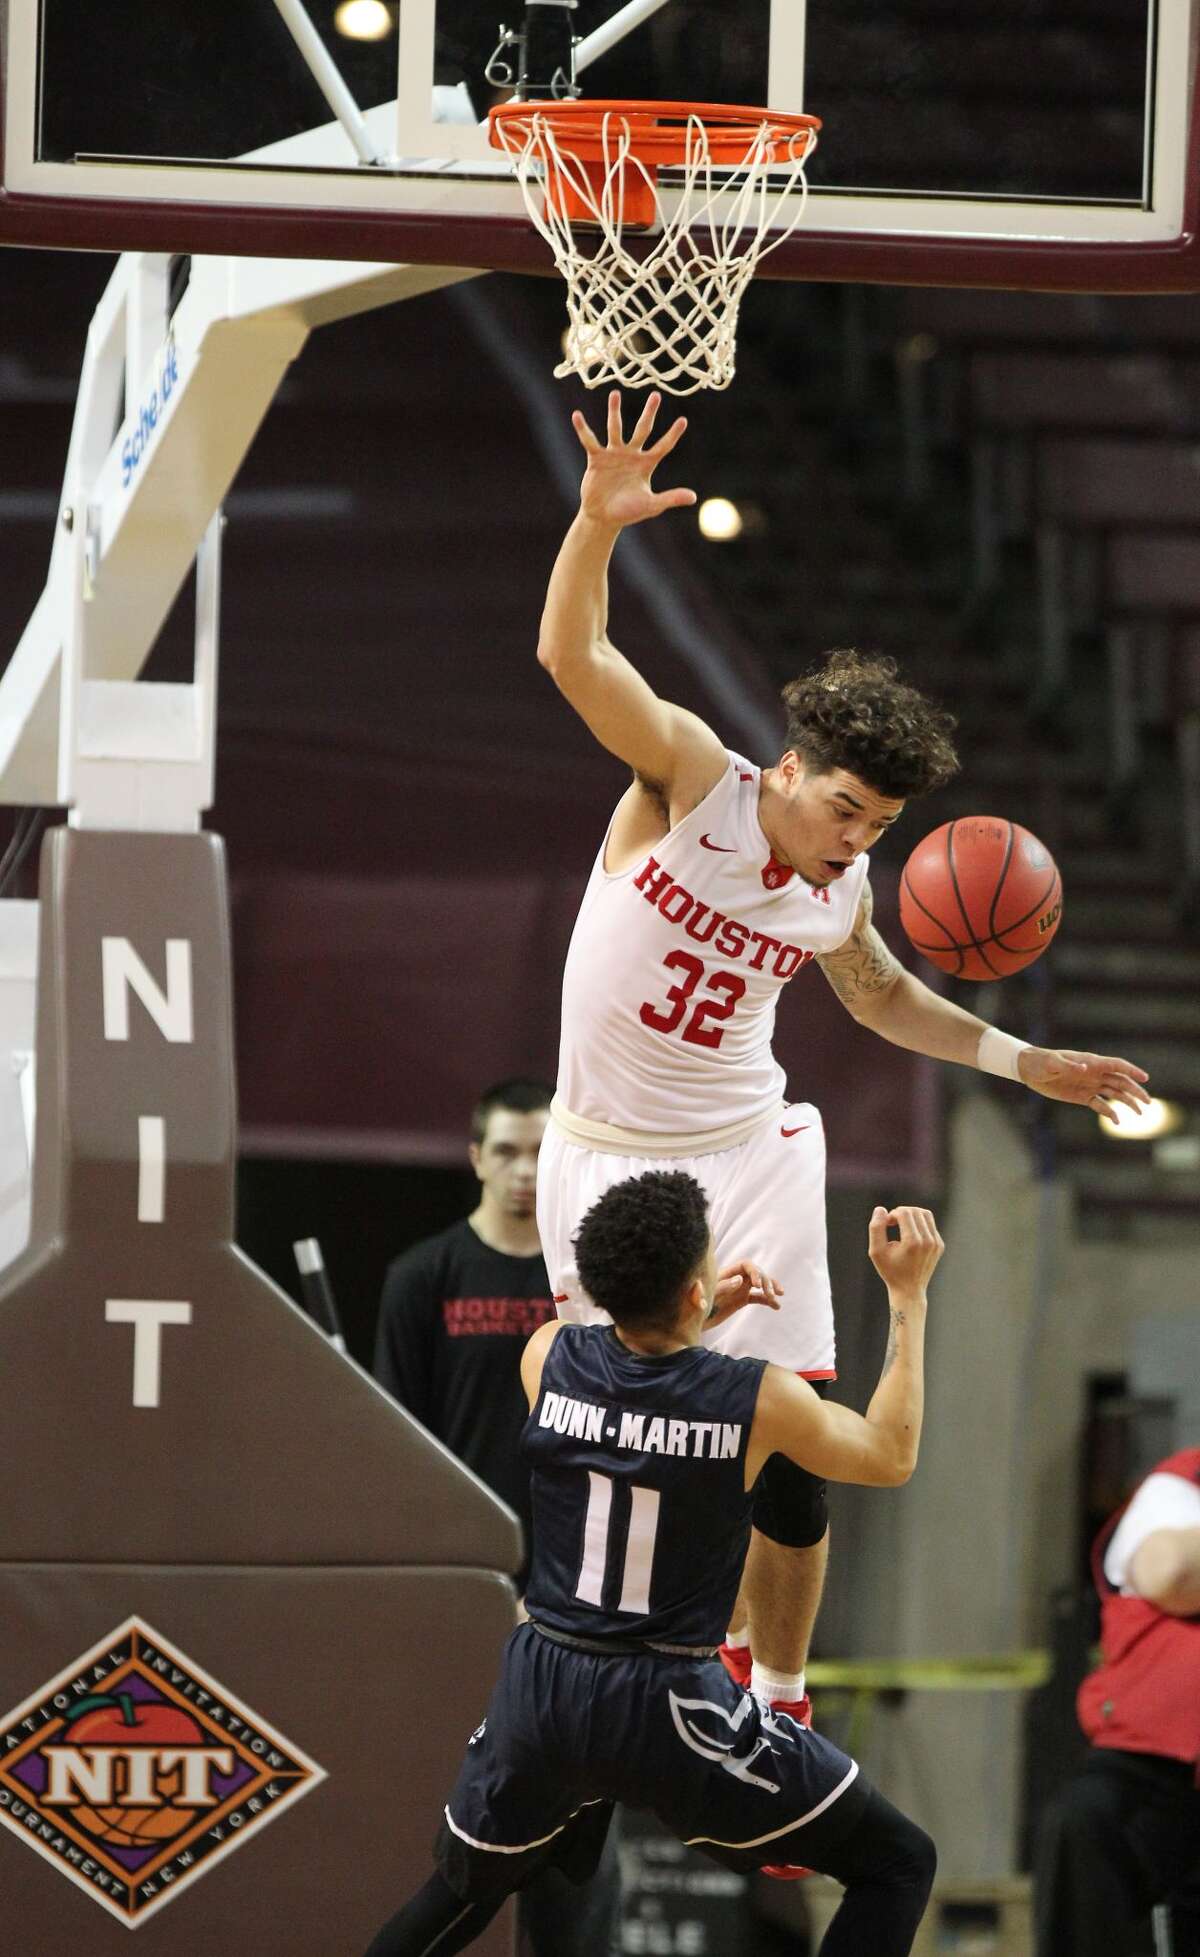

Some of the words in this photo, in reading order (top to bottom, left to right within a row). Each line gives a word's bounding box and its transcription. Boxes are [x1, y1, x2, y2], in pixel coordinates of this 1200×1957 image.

[639, 949, 746, 1049] 32
[444, 1298, 557, 1321] HOUST
[575, 1470, 661, 1615] 11
[142, 1648, 284, 1768] INVITATION
[40, 1746, 236, 1806] NIT
[141, 1850, 195, 1897] NEW
[210, 1784, 281, 1841] YORK
